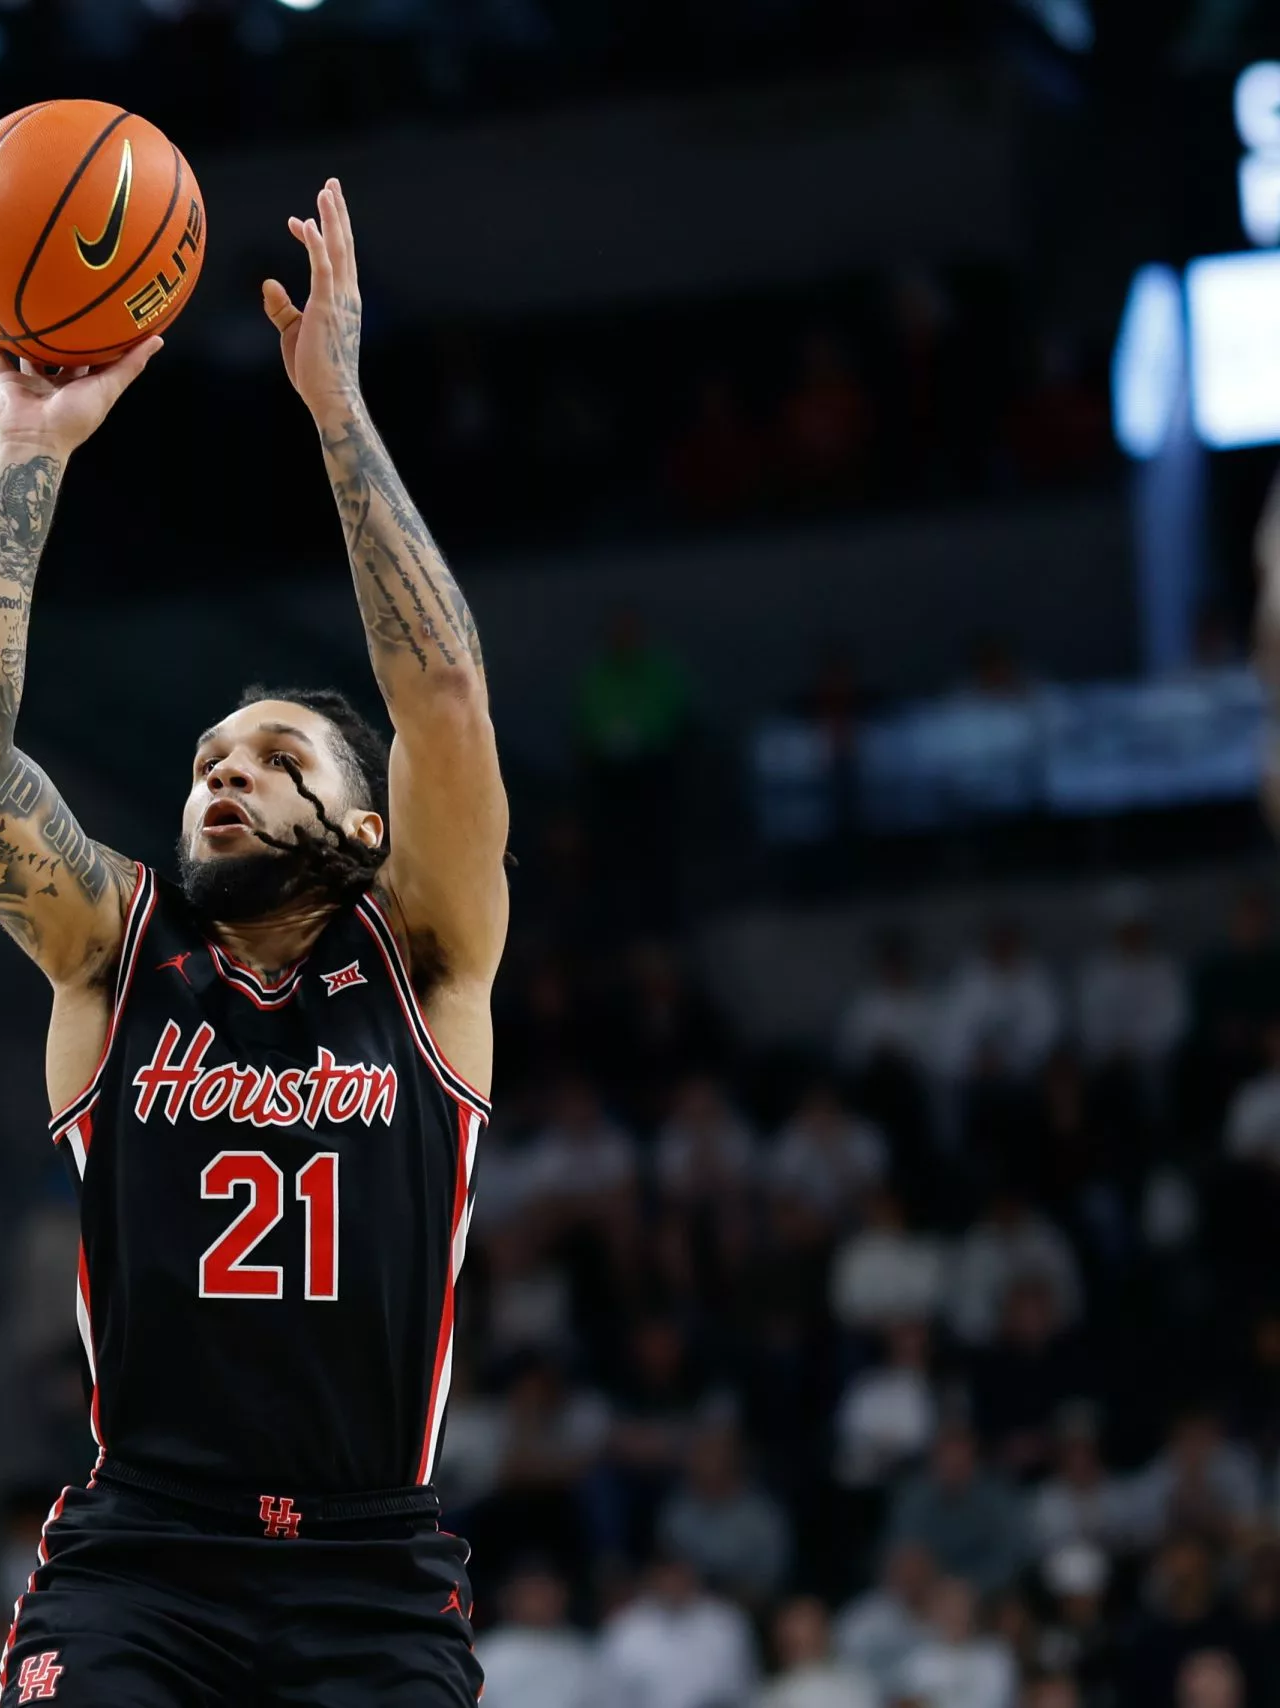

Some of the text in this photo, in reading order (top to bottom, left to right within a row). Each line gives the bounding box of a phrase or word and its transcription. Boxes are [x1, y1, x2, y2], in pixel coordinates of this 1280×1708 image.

[123, 197, 203, 325] ELITE
[132, 1018, 398, 1130] Houston
[199, 1151, 338, 1300] 21
[259, 1494, 301, 1540] UH
[19, 1649, 63, 1704] UH
